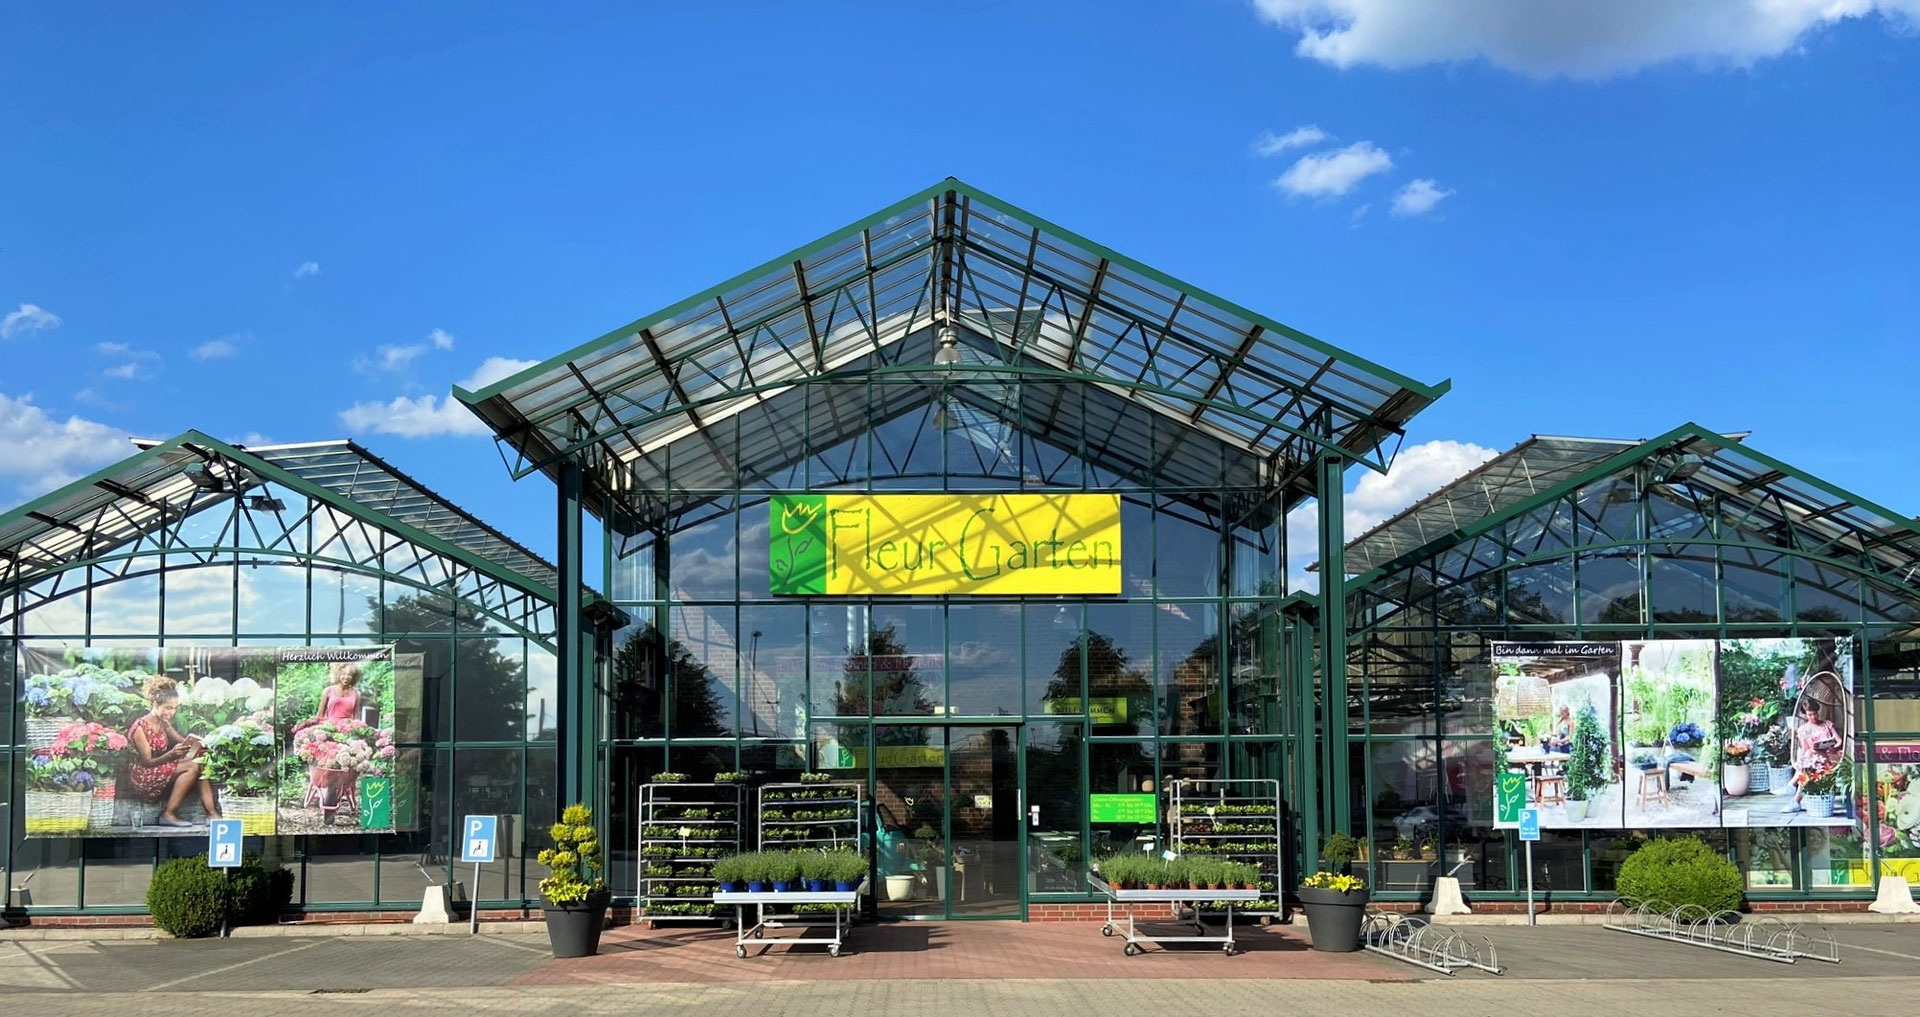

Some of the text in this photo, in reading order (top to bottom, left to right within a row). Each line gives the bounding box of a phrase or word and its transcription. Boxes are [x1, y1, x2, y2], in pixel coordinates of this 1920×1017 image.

[829, 507, 1113, 581] Fleur Garten
[282, 649, 389, 661] Herzlich Willkommen
[1496, 644, 1614, 655] Bin dann mal im Garten
[1880, 746, 1893, 760] &
[1522, 811, 1531, 823] P
[217, 824, 228, 842] P
[471, 820, 483, 837] P
